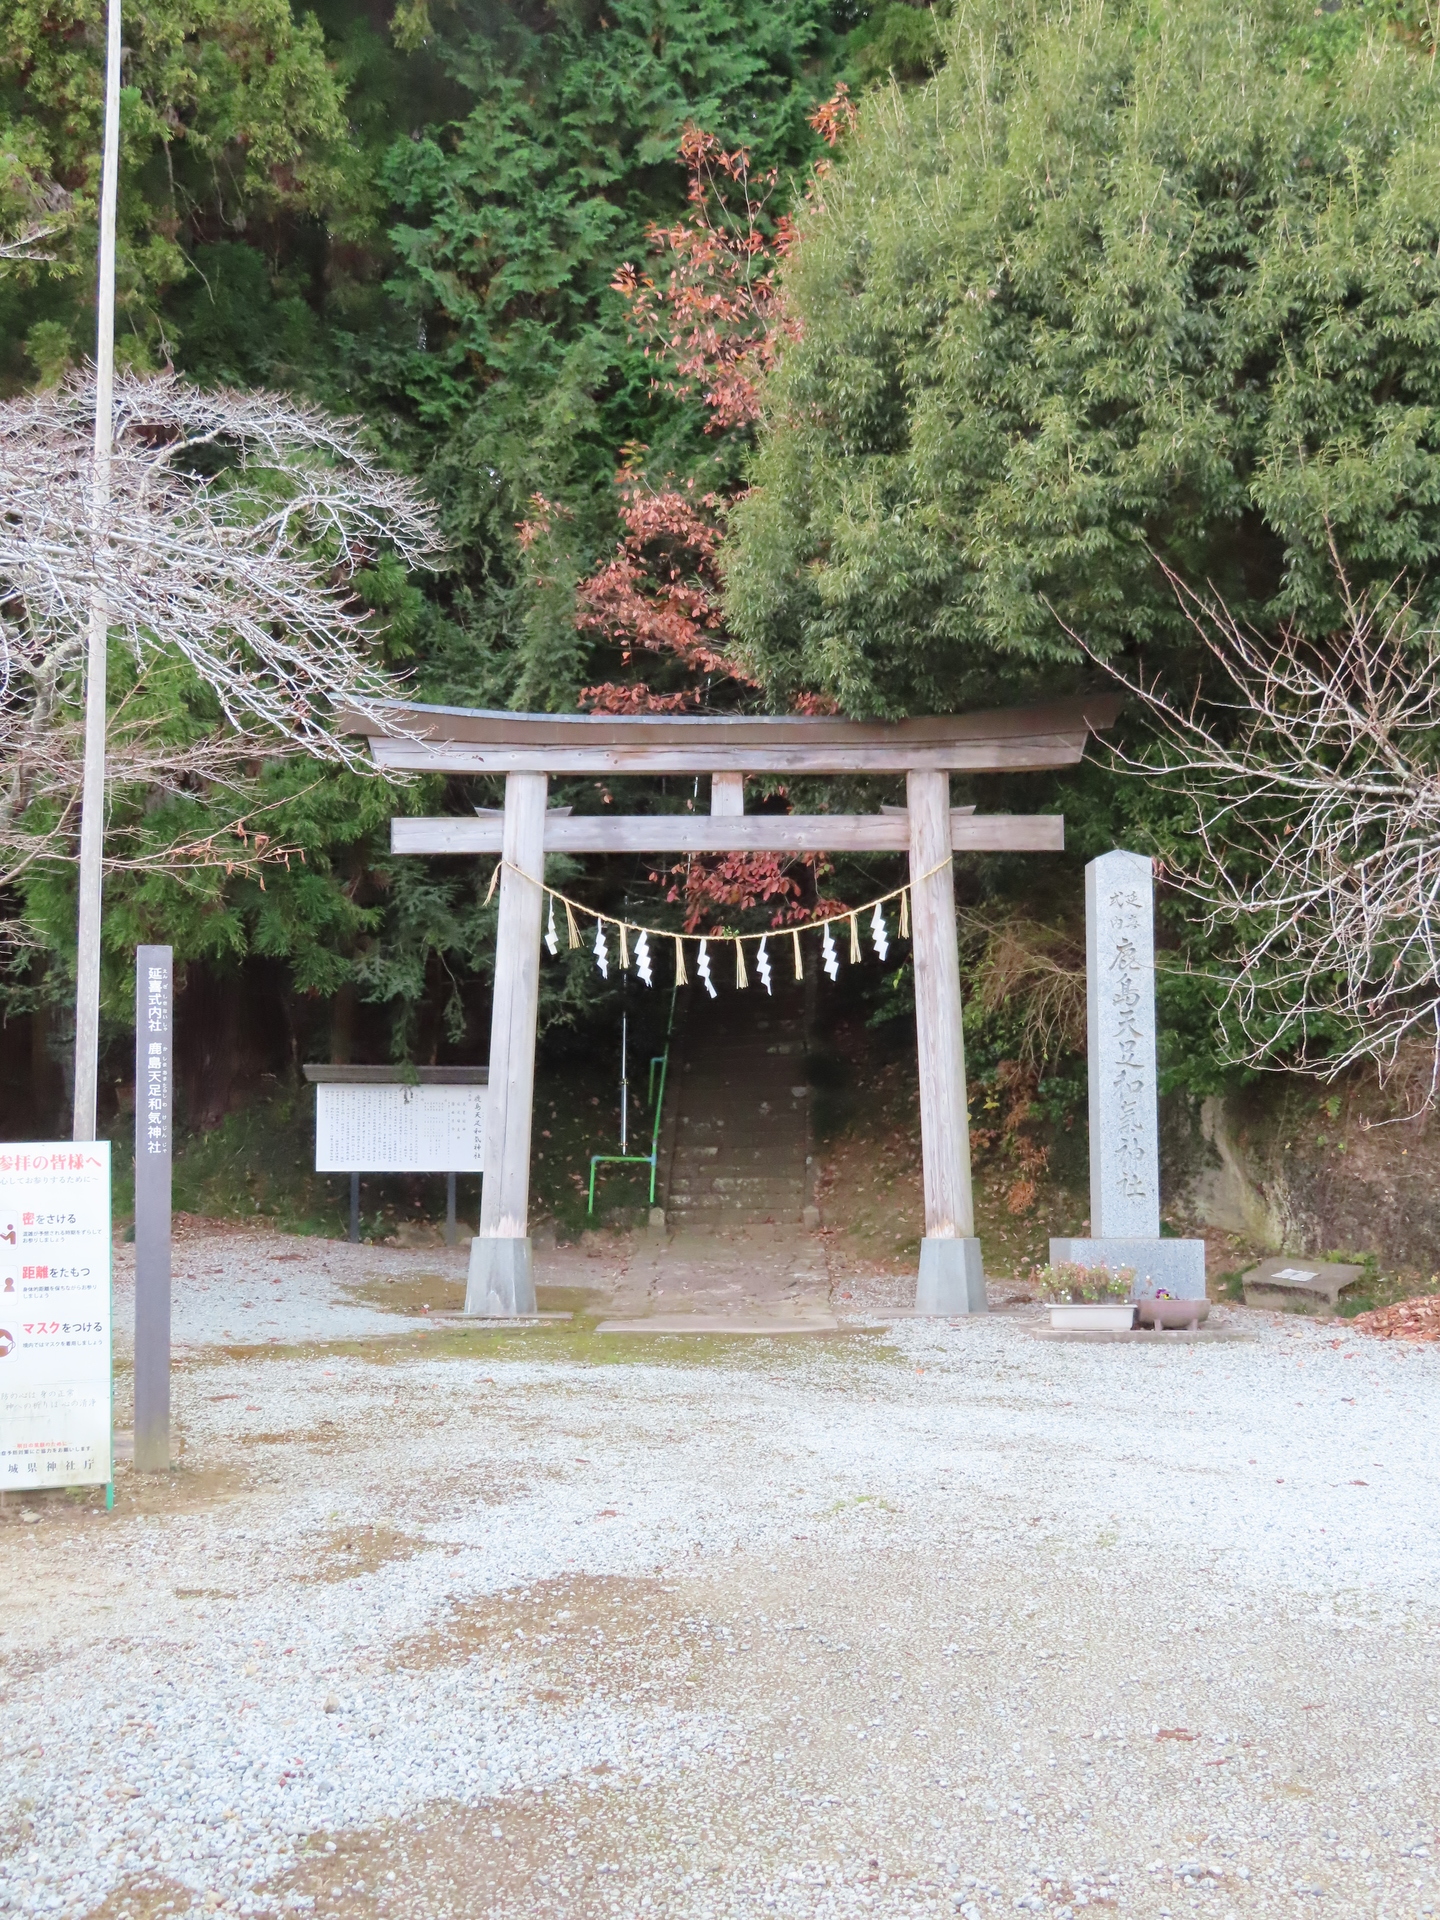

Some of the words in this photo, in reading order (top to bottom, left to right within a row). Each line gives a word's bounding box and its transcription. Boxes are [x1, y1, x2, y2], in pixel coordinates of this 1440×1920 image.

[148, 967, 162, 1032] 延喜式内社
[147, 1042, 162, 1154] 鹿島天足和気神社
[22, 1211, 77, 1226] 密をさける
[22, 1265, 91, 1279] 距離をたもつ
[22, 1321, 103, 1334] マスクをつける
